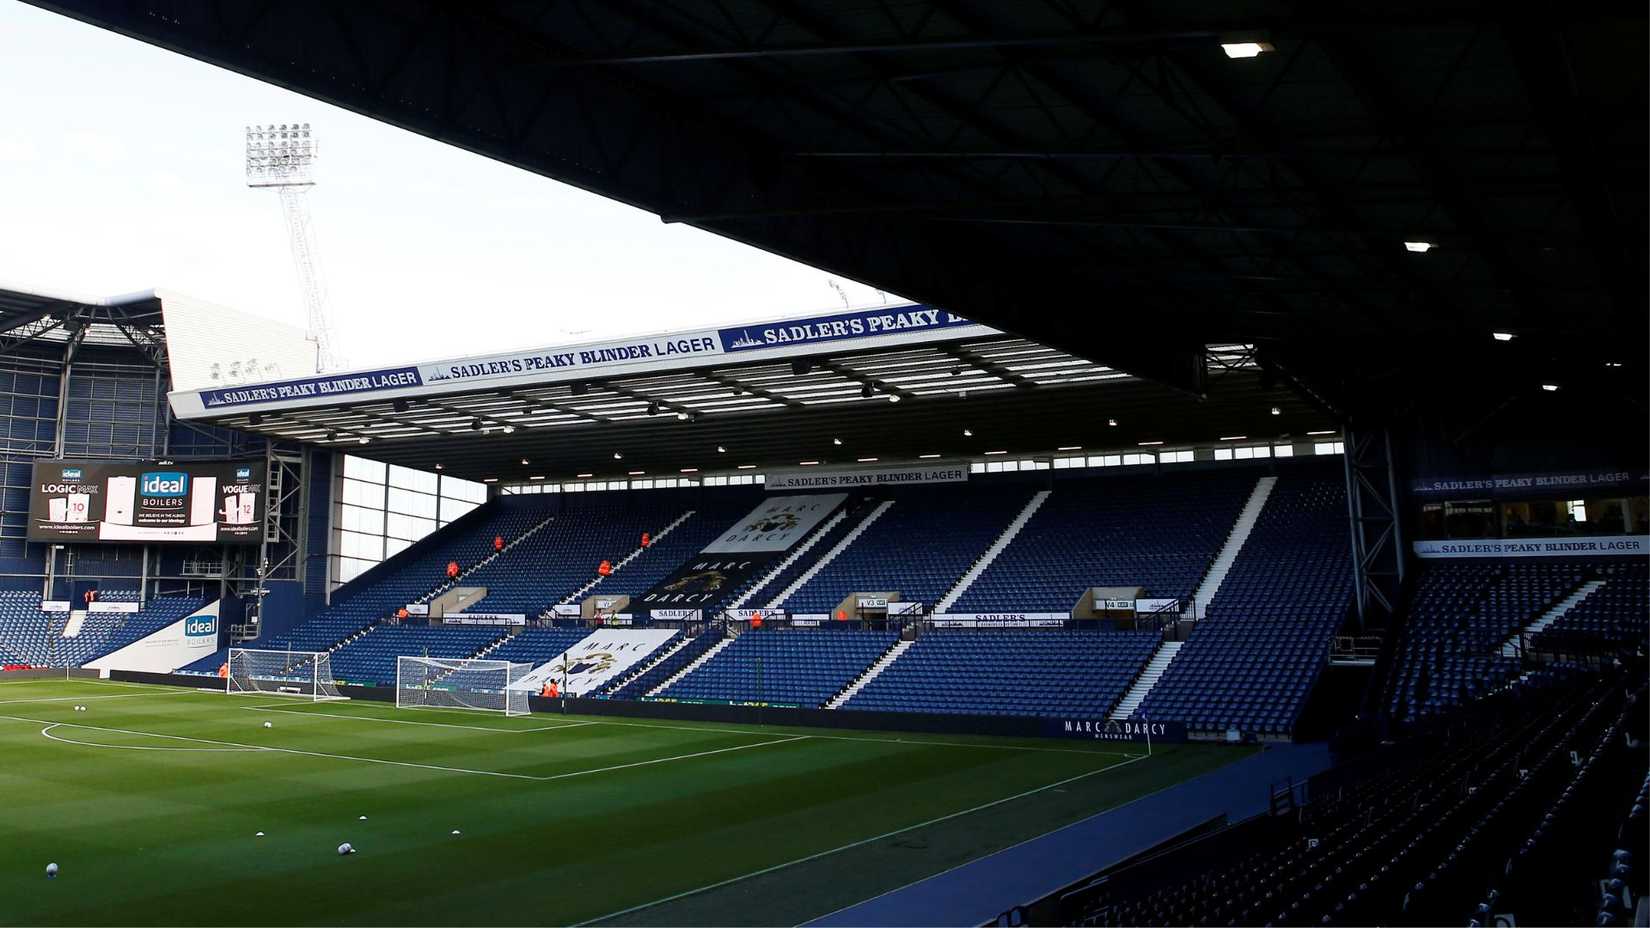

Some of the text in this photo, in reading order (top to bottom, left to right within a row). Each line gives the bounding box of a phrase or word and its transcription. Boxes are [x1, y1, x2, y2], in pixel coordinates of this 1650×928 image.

[764, 319, 865, 345] SADLER'S
[867, 309, 940, 332] PEAKY
[450, 337, 716, 379] SADLER'S PEAKY BLINDER LAGER
[224, 371, 418, 405] SADLER'S PEAKY BLINDER LAGER
[144, 475, 185, 493] ideal
[788, 470, 962, 487] SADLER'S PEAKY BLINDER LAGER
[1433, 472, 1630, 491] SADLER'S PEAKY BLINDER LAGER
[42, 484, 76, 493] LOGIC
[222, 485, 248, 493] VOGUE
[143, 498, 183, 506] BOILERS
[767, 503, 821, 513] MARC
[725, 531, 792, 543] DARCY
[1442, 541, 1640, 554] SADLER'S PEAKY BLINDER LAGER
[692, 561, 752, 570] MARC
[643, 593, 714, 602] DARCY
[975, 614, 1026, 622] SADLER'S
[187, 618, 215, 634] ideal
[584, 642, 646, 651] MARC
[1064, 720, 1166, 736] MARC DARCY
